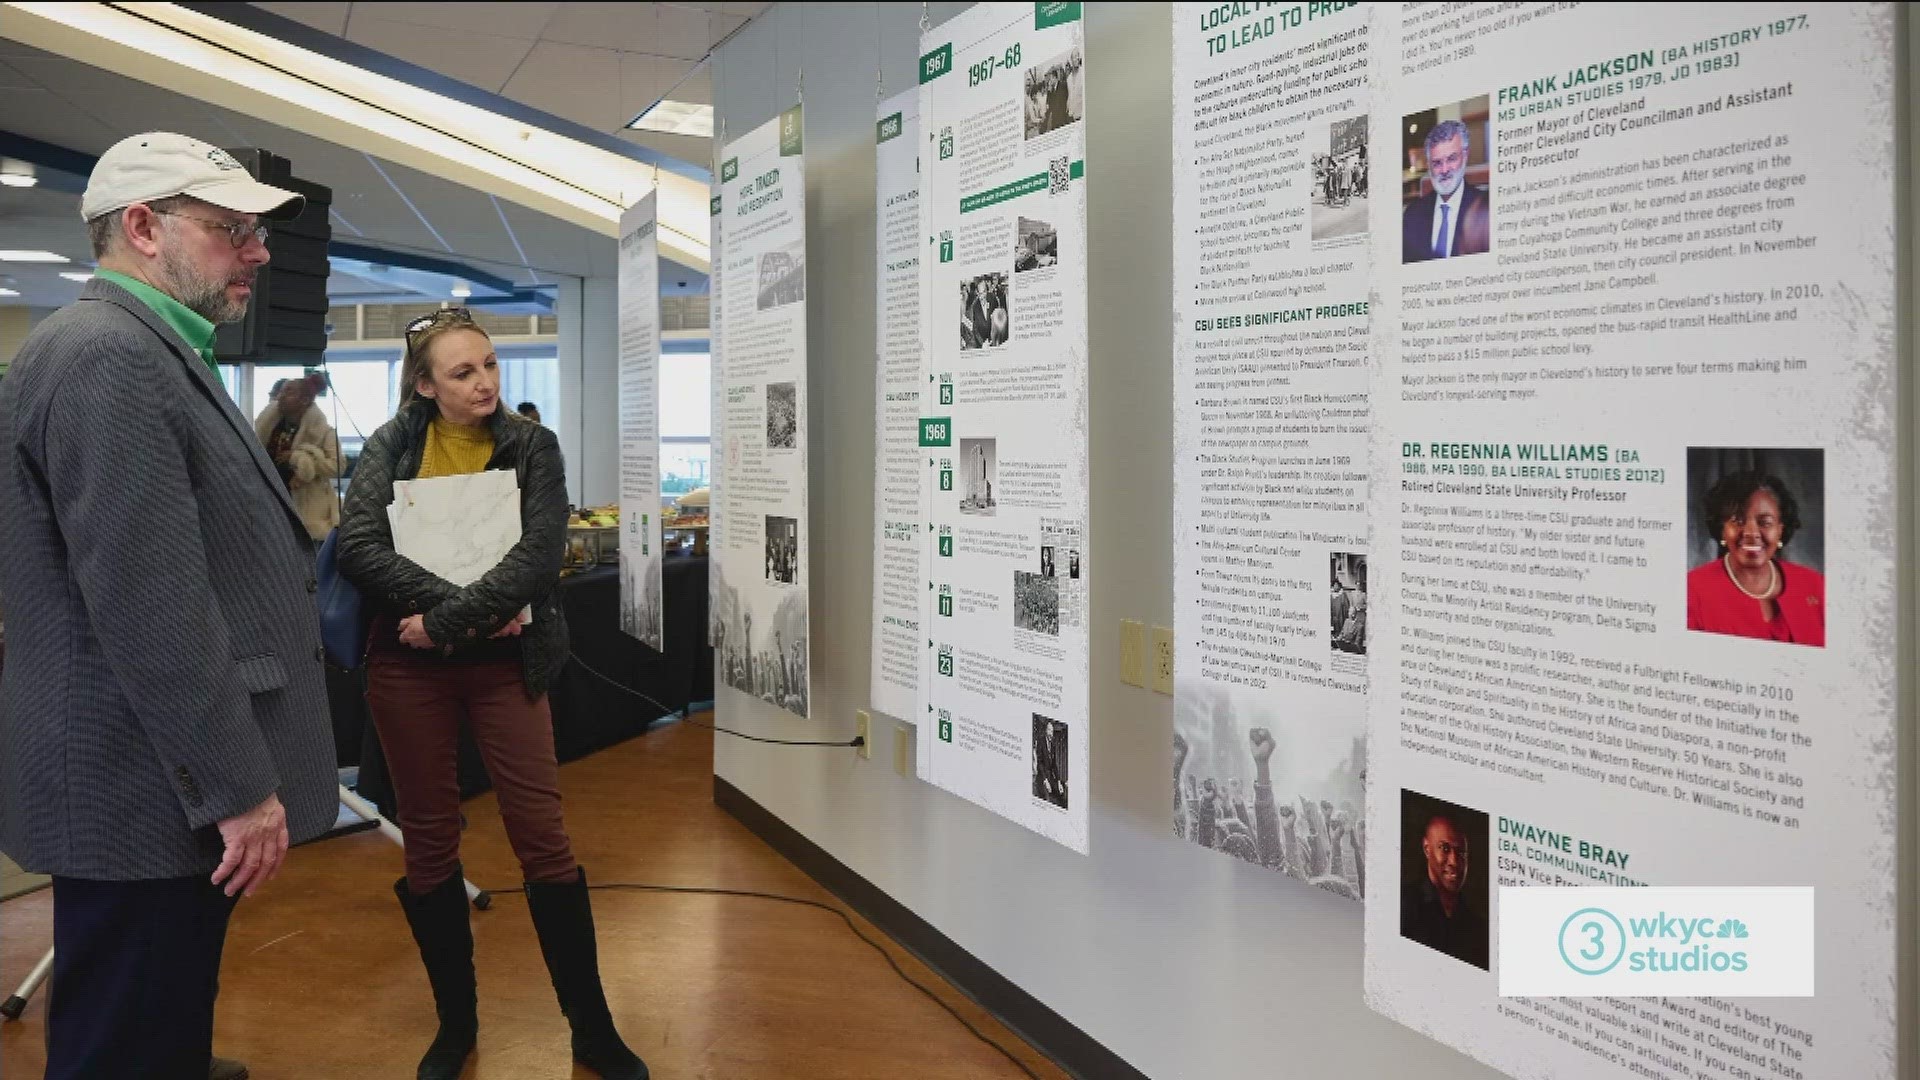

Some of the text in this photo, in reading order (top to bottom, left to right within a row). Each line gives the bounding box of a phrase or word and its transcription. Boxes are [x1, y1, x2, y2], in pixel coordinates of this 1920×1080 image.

[1200, 2, 1251, 31] LOCAL
[1206, 33, 1226, 57] TO
[1231, 15, 1275, 49] LEAD
[1279, 6, 1302, 31] TO
[926, 53, 946, 75] 1967
[1497, 75, 1558, 105] FRANK
[1561, 49, 1654, 89] JACKSON
[1692, 26, 1762, 55] HISTORY
[1766, 13, 1810, 36] 1977,
[1498, 107, 1516, 122] MS
[1519, 96, 1562, 117] URBAN
[1567, 81, 1624, 106] STUDIES
[1628, 71, 1666, 90] 1979,
[1670, 64, 1690, 81] JD
[1497, 96, 1646, 141] Former Mayor of Cleveland
[1497, 81, 1793, 157] Former Cleveland City Councilman and Assistant
[1497, 147, 1580, 173] City Prosecutor
[1497, 134, 1790, 196] Frank Jackson's administration has been characterized as
[943, 244, 949, 261] 7
[1497, 217, 1783, 266] Cleveland State University. He became an assistant city
[1195, 318, 1213, 331] CSU
[1216, 315, 1241, 329] SEES
[1245, 307, 1311, 327] SIGNIFICANT
[1401, 283, 1824, 333] Mayor Jackson faced one of the worst economic climates in Cleveland's history. In 2010,
[941, 386, 951, 403] 15
[925, 424, 946, 440] 1968
[1401, 441, 1425, 458] DR.
[1430, 443, 1512, 459] REGENNIA
[1516, 443, 1609, 462] WILLIAMS
[943, 472, 949, 489] 8
[1401, 461, 1428, 475] 1986,
[1431, 463, 1455, 475] MPA
[1458, 463, 1487, 476] 1990,
[1491, 465, 1507, 477] BA
[1510, 465, 1561, 479] LIBERAL
[1564, 467, 1621, 481] STUDIES
[1401, 479, 1627, 502] Retired Cleveland State University Professor
[942, 539, 949, 555] 4
[942, 598, 950, 615] 11
[1400, 625, 1794, 702] Dr. Williams joined the CSU faculty in 1992, received a Fulbright Fellowship in 2010
[942, 723, 948, 739] 6
[1498, 815, 1629, 870] DWAYNE BRAY
[1497, 855, 1552, 885] ESPN Vice
[1661, 995, 1802, 1061] Award and editor of The
[1743, 1007, 1772, 1029] best
[1773, 1021, 1813, 1047] young
[1639, 1009, 1660, 1025] and
[1661, 1018, 1691, 1037] write
[1692, 1030, 1705, 1043] at
[1707, 1033, 1766, 1068] Cleveland
[1769, 1057, 1804, 1080] State
